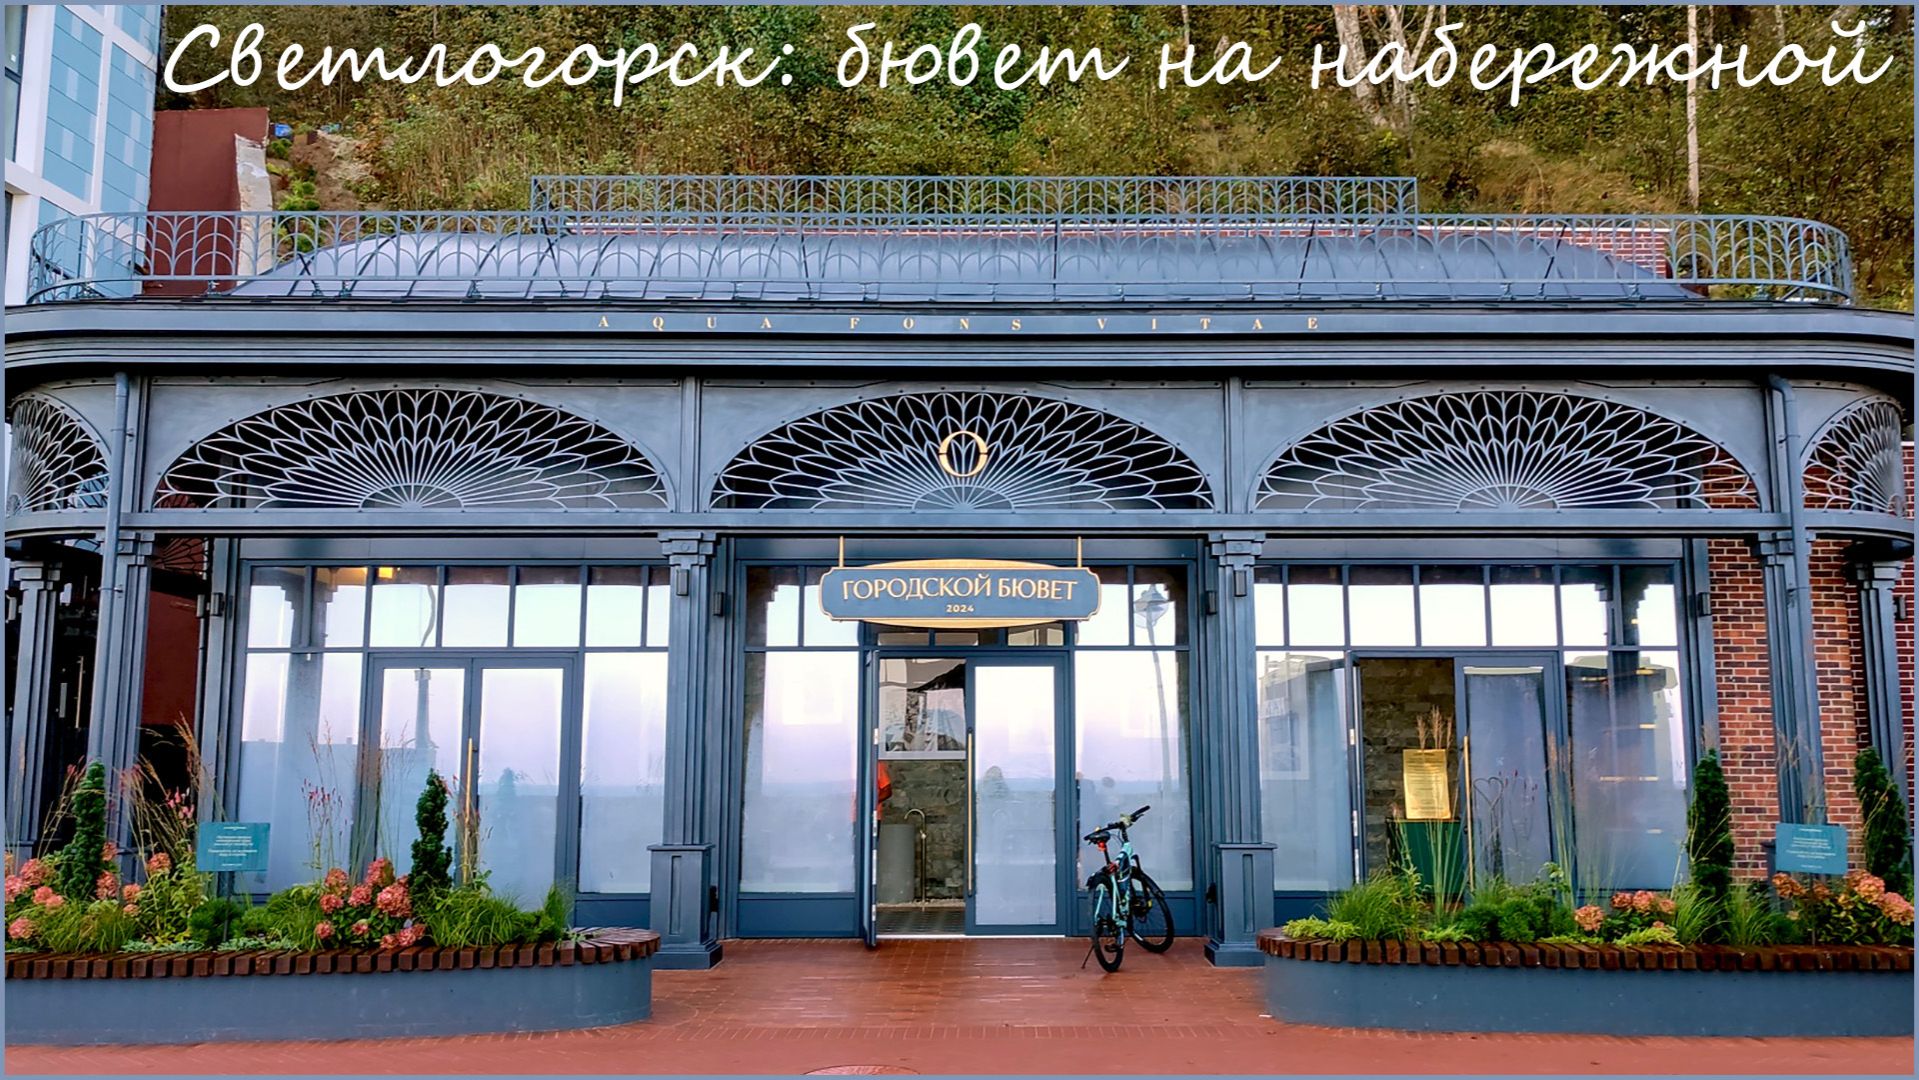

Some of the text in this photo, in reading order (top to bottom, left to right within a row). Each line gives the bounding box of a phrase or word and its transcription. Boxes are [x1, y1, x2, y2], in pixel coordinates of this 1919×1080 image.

[598, 315, 1319, 332] AQUA FONS VITAE
[842, 573, 1079, 600] ГОРОДСКОЙ БЮВЕТ
[945, 604, 975, 614] 2024
